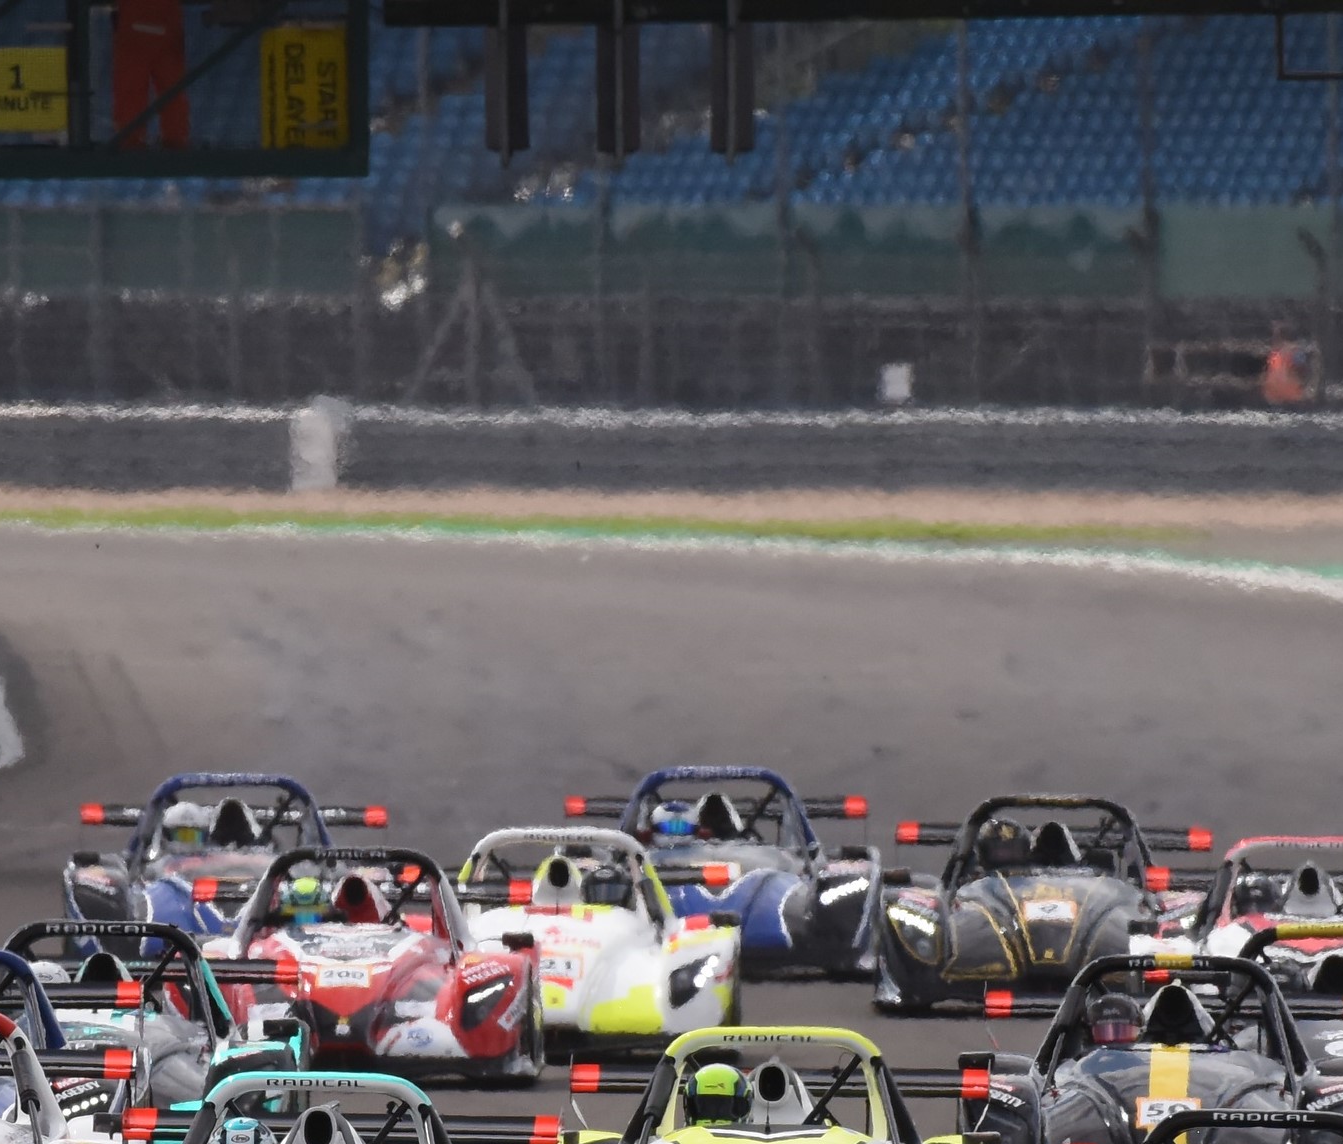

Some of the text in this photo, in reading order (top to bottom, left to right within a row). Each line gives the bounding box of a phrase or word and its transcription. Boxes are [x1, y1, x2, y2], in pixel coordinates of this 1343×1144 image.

[9, 64, 24, 90] 1
[284, 43, 305, 147] DELAYE
[46, 924, 154, 934] RADICAL
[266, 1078, 367, 1088] RADICAL
[54, 1080, 101, 1104] AGERTY
[1212, 1112, 1315, 1122] RADICAL
